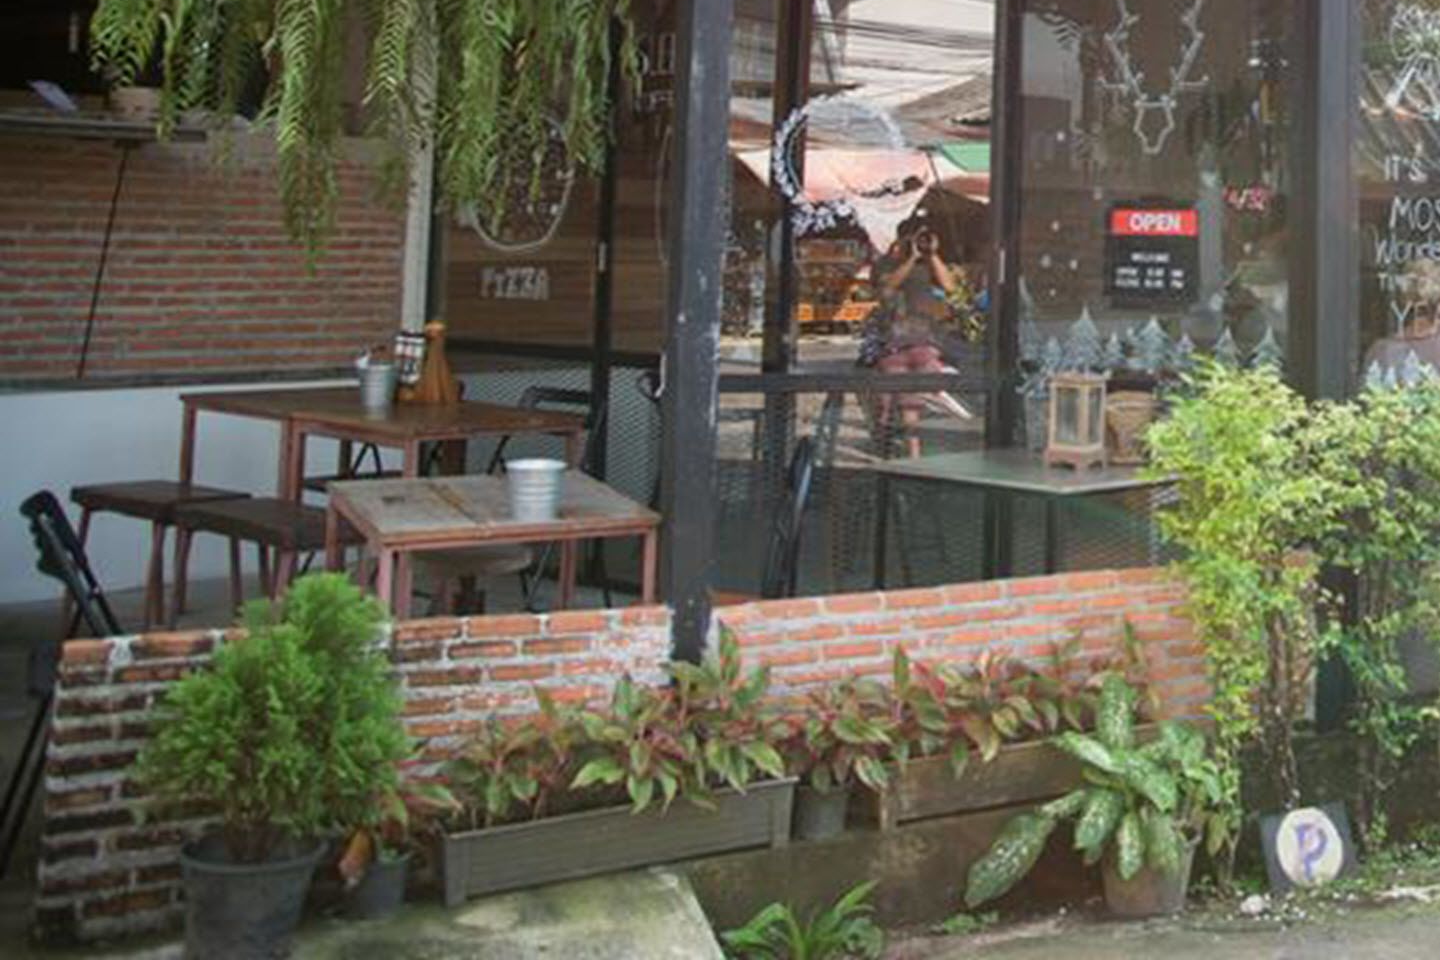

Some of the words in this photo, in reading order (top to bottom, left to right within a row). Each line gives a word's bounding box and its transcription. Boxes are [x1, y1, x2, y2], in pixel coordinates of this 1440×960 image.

[1384, 155, 1427, 182] IT'S
[1129, 212, 1182, 231] OPEN
[480, 266, 549, 300] PIZZA
[1296, 822, 1328, 881] P
